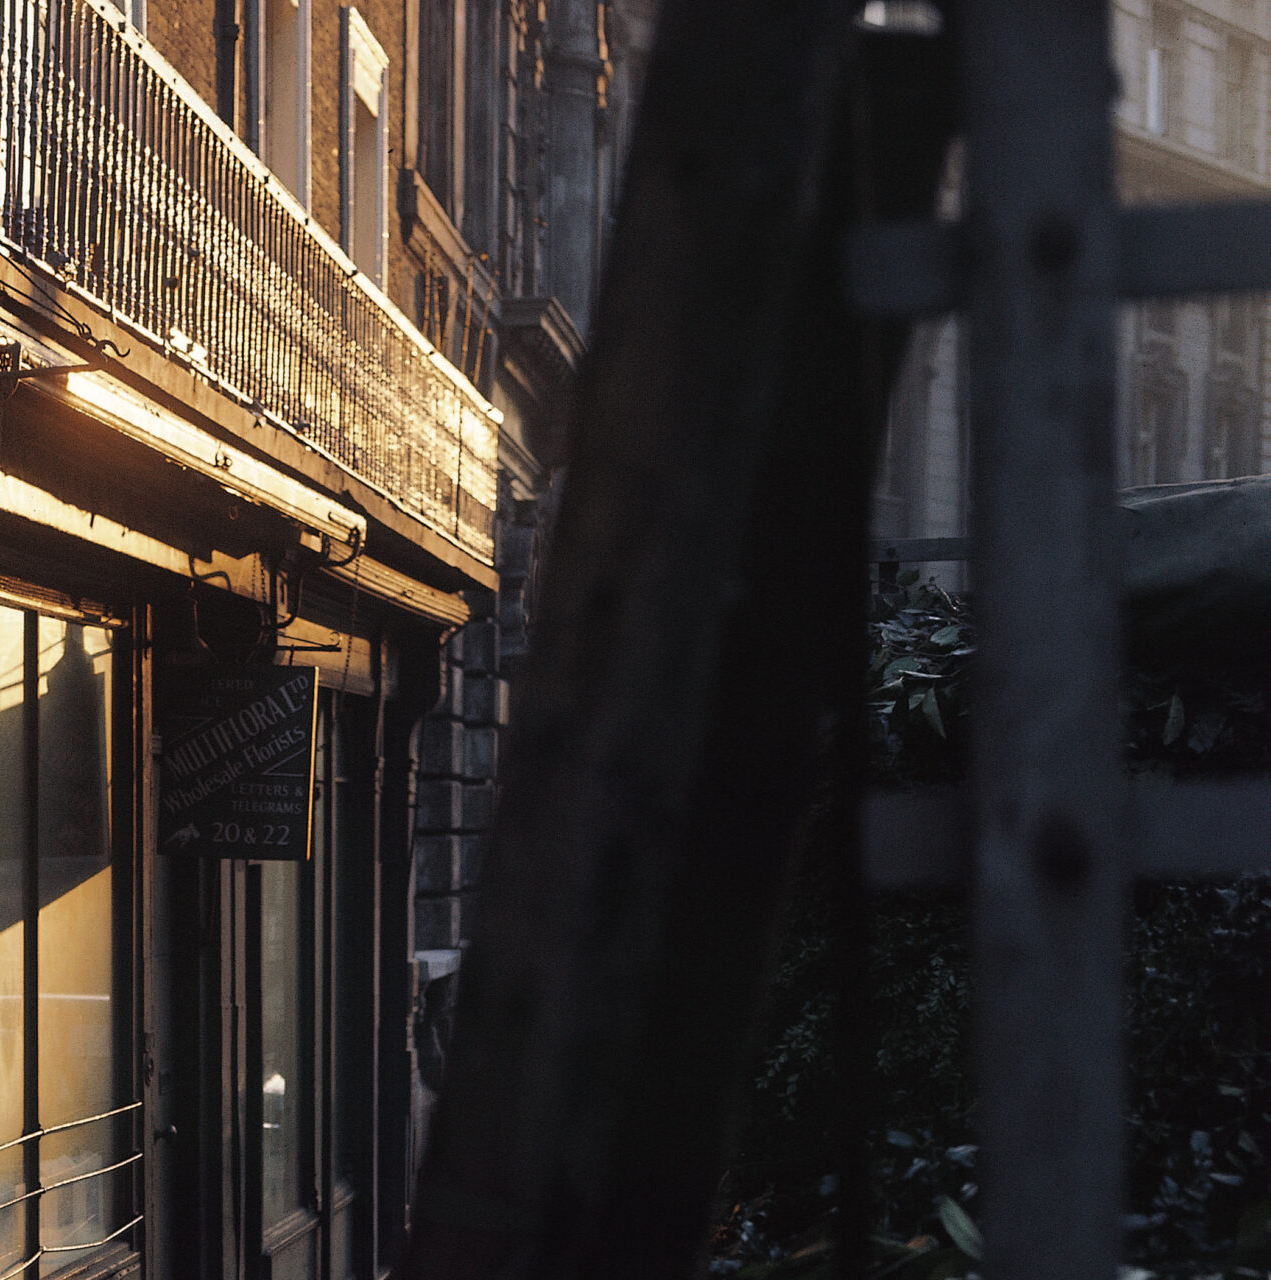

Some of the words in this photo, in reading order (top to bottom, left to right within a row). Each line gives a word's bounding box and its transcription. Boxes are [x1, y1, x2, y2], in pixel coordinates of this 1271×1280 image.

[165, 694, 286, 782] MULTIFLORA
[163, 759, 244, 814] Wholesale
[242, 724, 307, 769] Florists
[231, 783, 289, 797] LETTERS
[295, 786, 304, 797] &
[231, 800, 302, 814] TELEGRAMS
[212, 822, 240, 843] 20
[244, 827, 256, 844] &
[263, 824, 290, 846] 22
